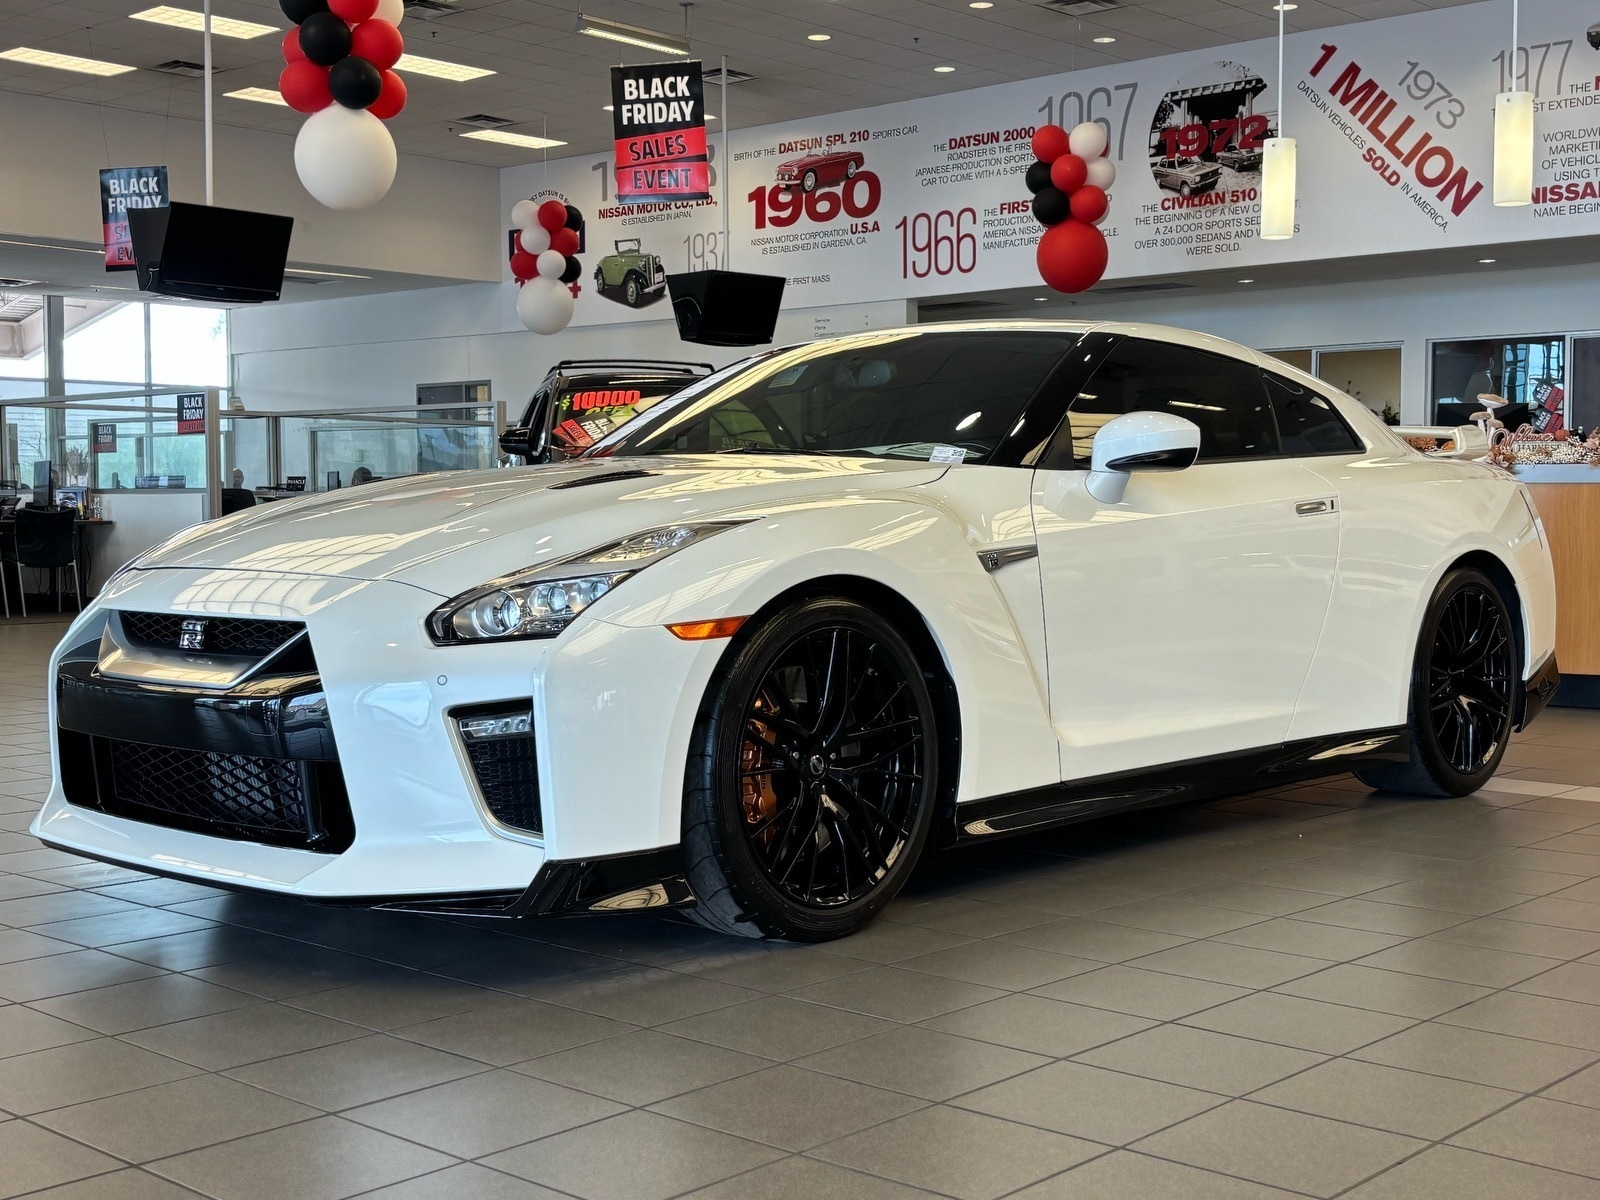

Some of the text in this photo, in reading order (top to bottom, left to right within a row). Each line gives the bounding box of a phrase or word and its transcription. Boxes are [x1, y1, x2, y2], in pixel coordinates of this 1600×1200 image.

[1492, 39, 1574, 99] 1977
[623, 76, 691, 101] BLACK
[1398, 60, 1465, 130] 1973
[1569, 81, 1592, 94] THE
[621, 101, 695, 126] FRIDAY
[933, 126, 1036, 153] THE DATSUN 2000
[1159, 114, 1268, 161] 1972
[1309, 43, 1484, 218] 1 MILLION
[1543, 127, 1600, 143] WORLDWI
[629, 134, 688, 162] SALES
[734, 151, 753, 161] BIRTH
[753, 149, 764, 159] OF
[763, 147, 777, 158] THE
[778, 137, 823, 155] DATSUN
[825, 132, 847, 148] SPL
[849, 129, 870, 144] 210
[872, 127, 901, 141] SPORTS
[947, 142, 1032, 162] ROADSTER IS THE FIRS
[914, 153, 1036, 178] JAPANESE-PRODUCTION SPORTS
[1297, 80, 1449, 234] DATSUN VEHICLES SOLD IN AMERICA.
[1541, 154, 1600, 170] OF VEHICL
[109, 175, 159, 195] BLACK
[633, 168, 692, 190] EVENT
[921, 164, 1031, 187] CAR TO COME WITH A 5-SPEE
[1554, 168, 1590, 182] USING
[748, 170, 882, 230] 1960
[1141, 187, 1257, 213] THE CIVILIAN 510
[1531, 180, 1600, 205] NISSA
[107, 195, 162, 215] FRIDAY
[598, 205, 634, 220] NISSAN
[637, 202, 672, 215] MOTOR
[983, 199, 1033, 217] THE FIRS
[1134, 216, 1151, 226] THE
[1153, 210, 1202, 224] BEGINNING
[1204, 207, 1218, 219] OF
[1219, 207, 1226, 217] A
[1228, 204, 1250, 215] NEW
[1533, 206, 1566, 218] NAME
[621, 218, 628, 226] IS
[628, 213, 665, 225] ESTABLISHED
[665, 211, 673, 221] IN
[983, 215, 1034, 228] PRODUCTION
[1154, 226, 1161, 236] A
[1205, 217, 1242, 231] SPORTS
[750, 220, 881, 247] NISSAN MOTOR CORPORATION U.S.A
[895, 207, 977, 279] 1966
[983, 228, 1017, 240] AMERICA
[983, 236, 1041, 250] MANUFACTURE
[1134, 239, 1158, 250] OVER
[1160, 235, 1193, 248] 300,000
[1195, 231, 1232, 244] SEDANS
[1234, 229, 1253, 239] AND
[761, 247, 769, 255] IS
[769, 243, 812, 254] ESTABLISHED
[812, 241, 820, 250] IN
[820, 238, 855, 249] GARDENA,
[1185, 242, 1241, 256] WERE SOLD.
[793, 276, 811, 286] FIRST
[811, 274, 831, 284] MASS
[183, 397, 203, 408] BLACK
[183, 409, 204, 420] FRIDAY
